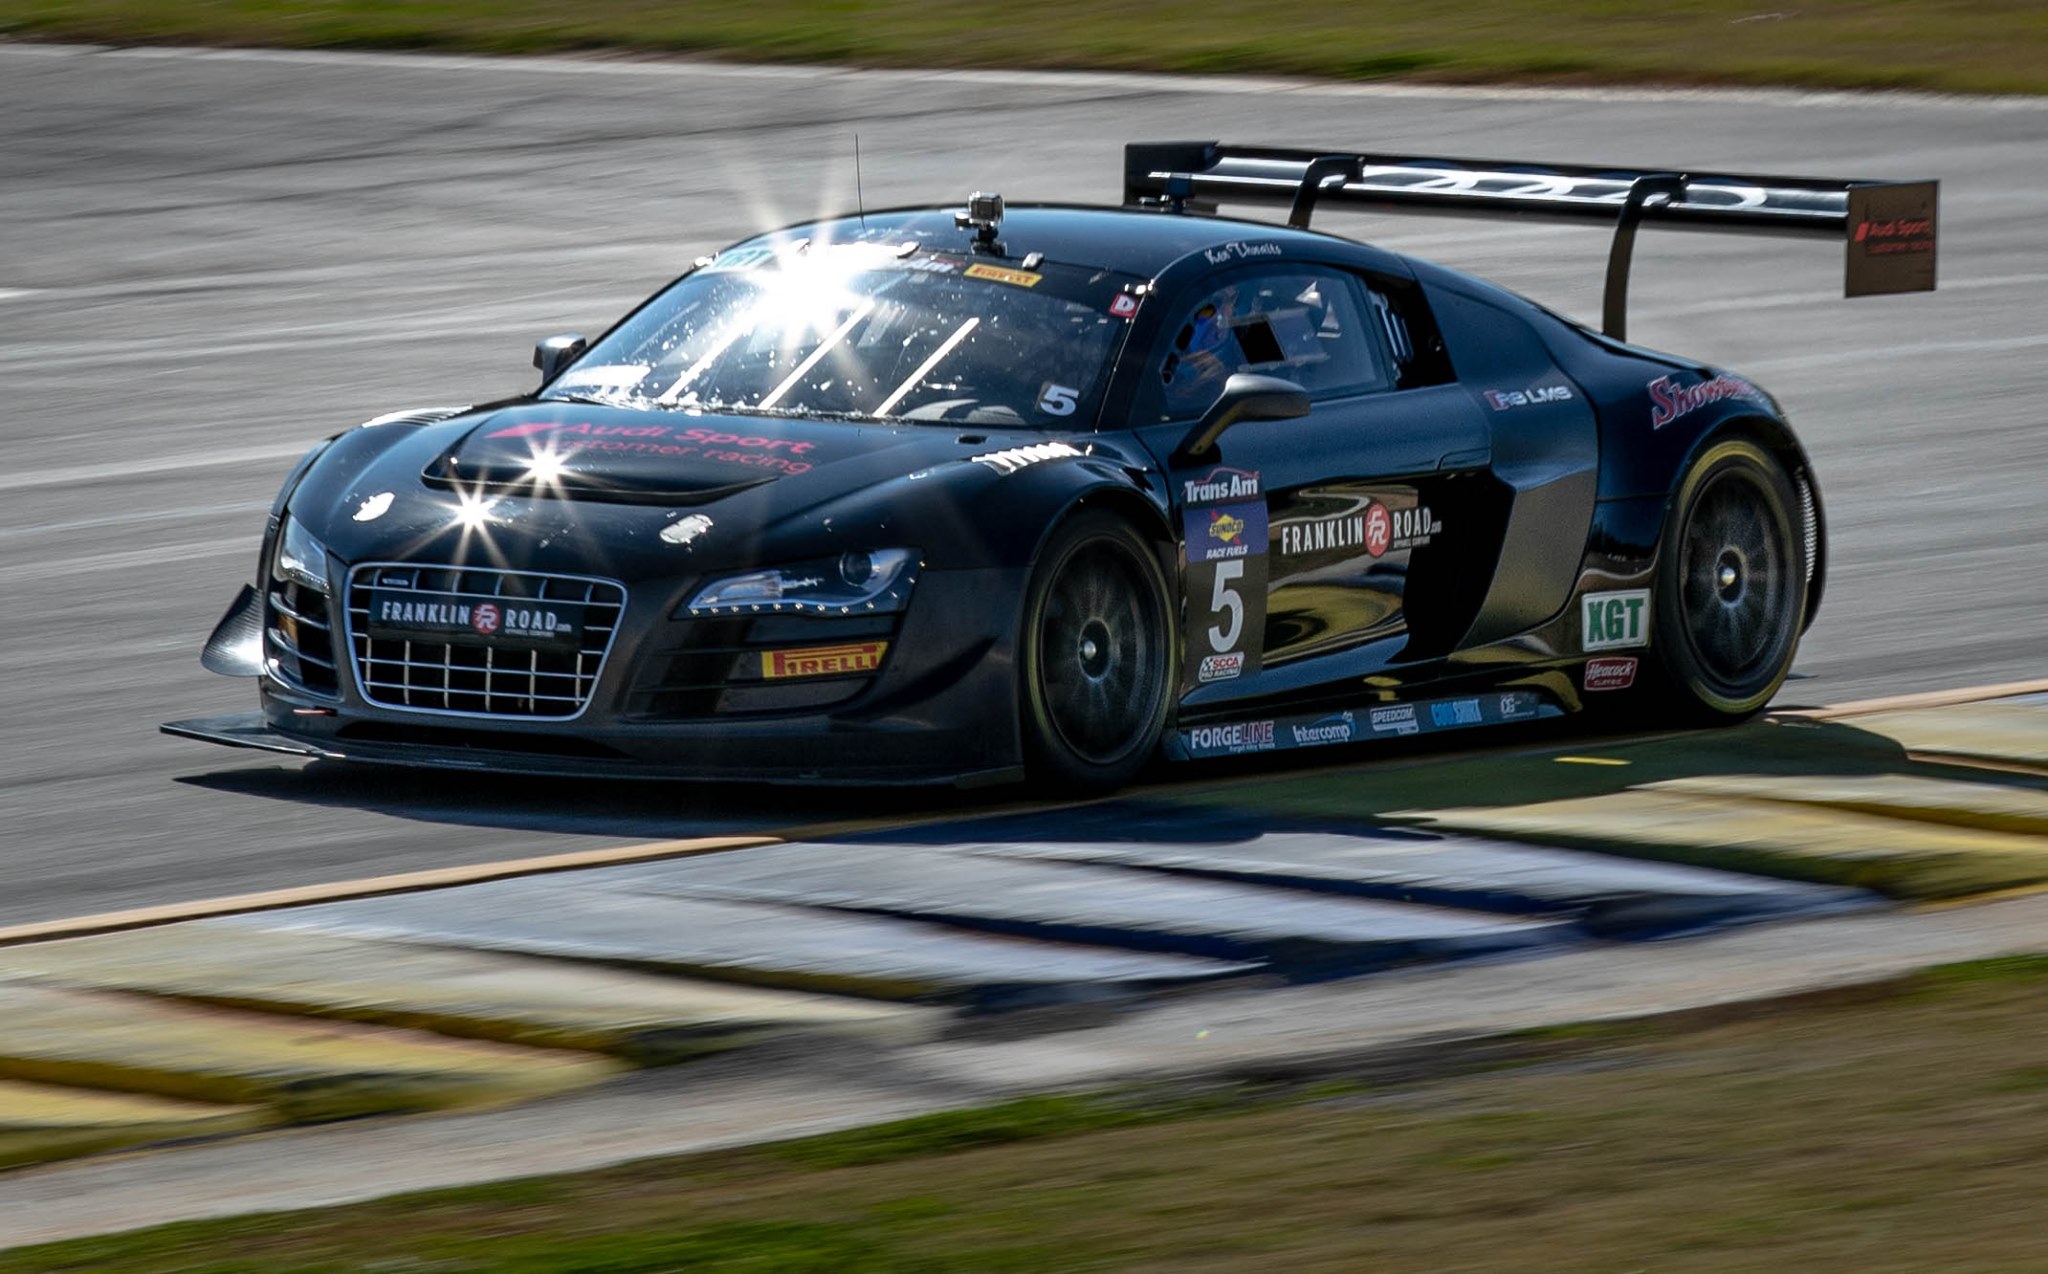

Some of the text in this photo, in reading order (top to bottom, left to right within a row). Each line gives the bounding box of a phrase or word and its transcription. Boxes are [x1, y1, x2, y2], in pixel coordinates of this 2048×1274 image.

[1039, 383, 1080, 417] 5
[556, 422, 816, 455] Audi Sport
[702, 450, 813, 475] racing
[1185, 474, 1258, 503] Trans Am
[1281, 516, 1363, 556] FRANKLIN
[1206, 544, 1249, 560] RACE FUELS
[381, 601, 471, 626] FRANKLIN
[1208, 558, 1244, 653] 5
[1587, 598, 1645, 643] XGT
[772, 642, 879, 677] PIRELLI
[1212, 656, 1240, 670] SCCA
[1371, 706, 1414, 724] SPEEDCOM
[1191, 720, 1275, 750] FORGELINE
[1292, 723, 1351, 743] Intercomp
